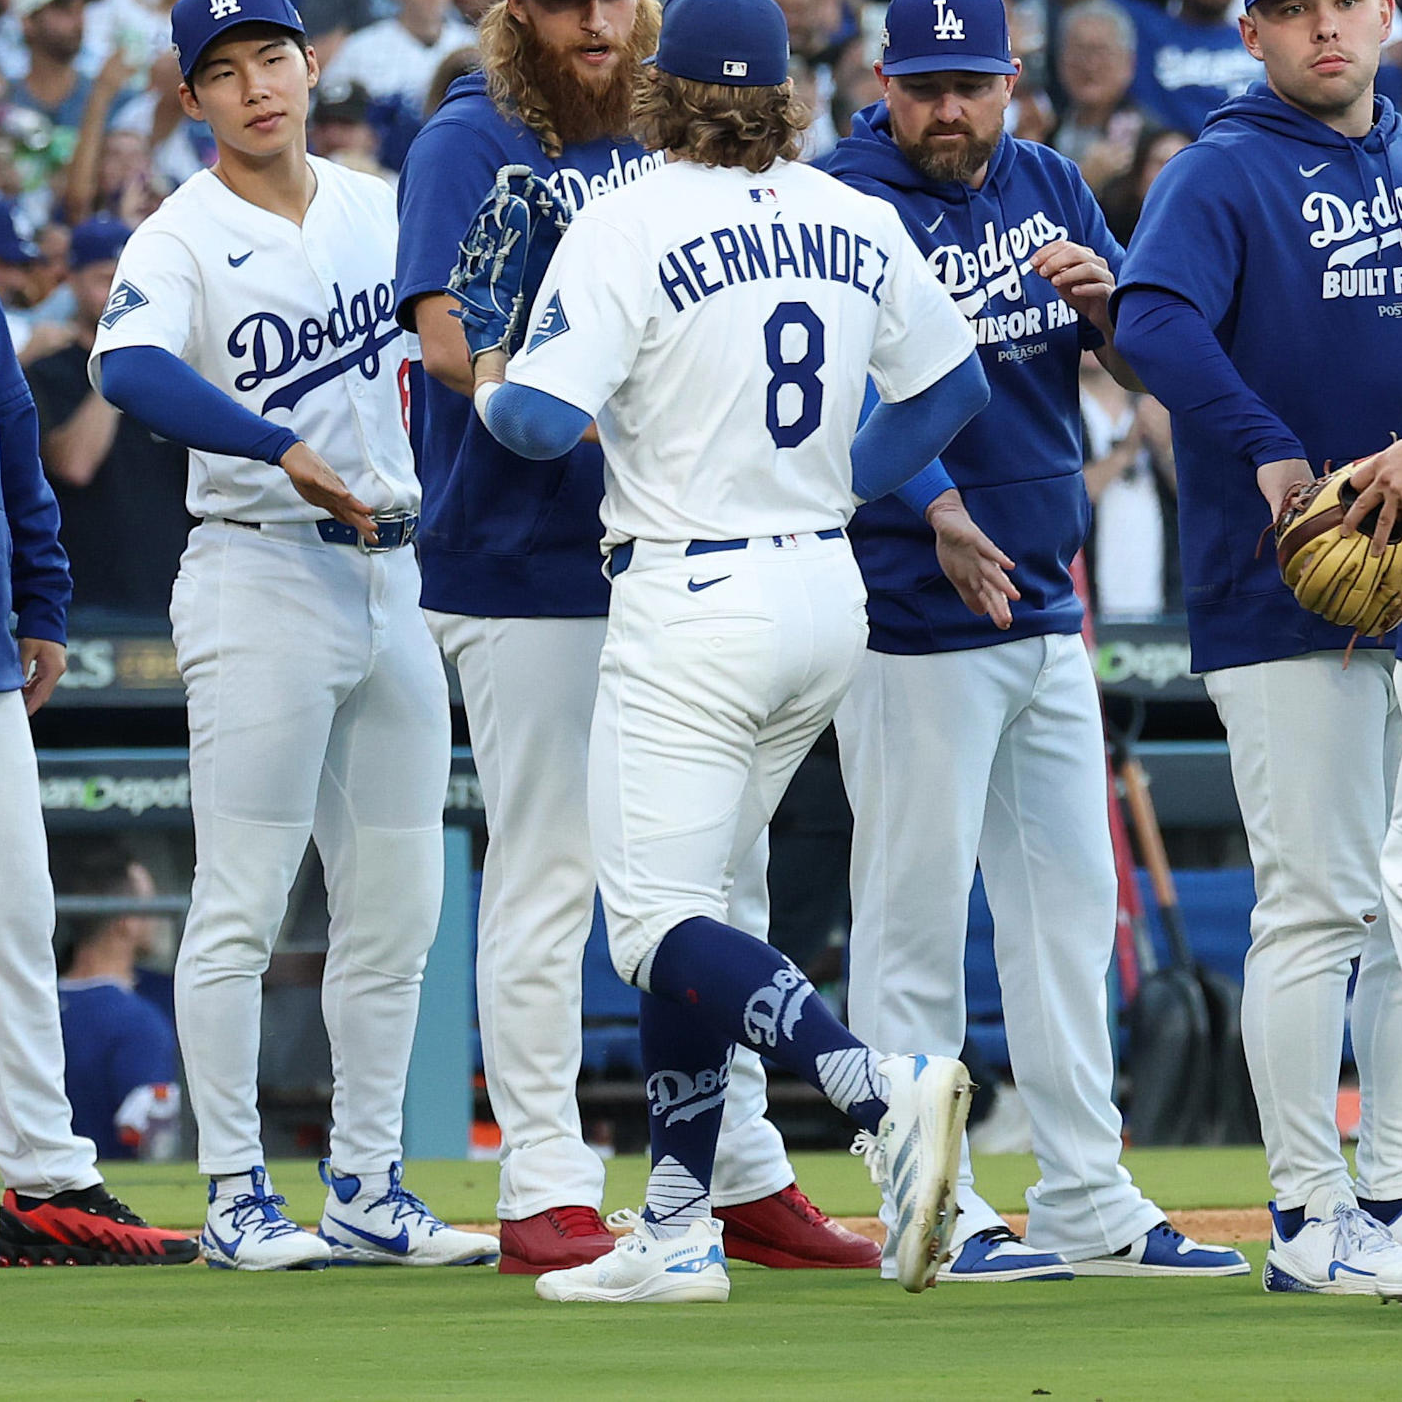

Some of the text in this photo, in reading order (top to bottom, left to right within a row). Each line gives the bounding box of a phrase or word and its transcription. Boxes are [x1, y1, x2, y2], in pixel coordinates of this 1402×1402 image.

[932, 0, 966, 40] LA
[658, 211, 890, 313] HERNÁNDEZ
[1322, 266, 1388, 300] BUILT
[227, 282, 400, 408] Dodge
[998, 302, 1042, 342] FOR
[763, 301, 826, 449] 8
